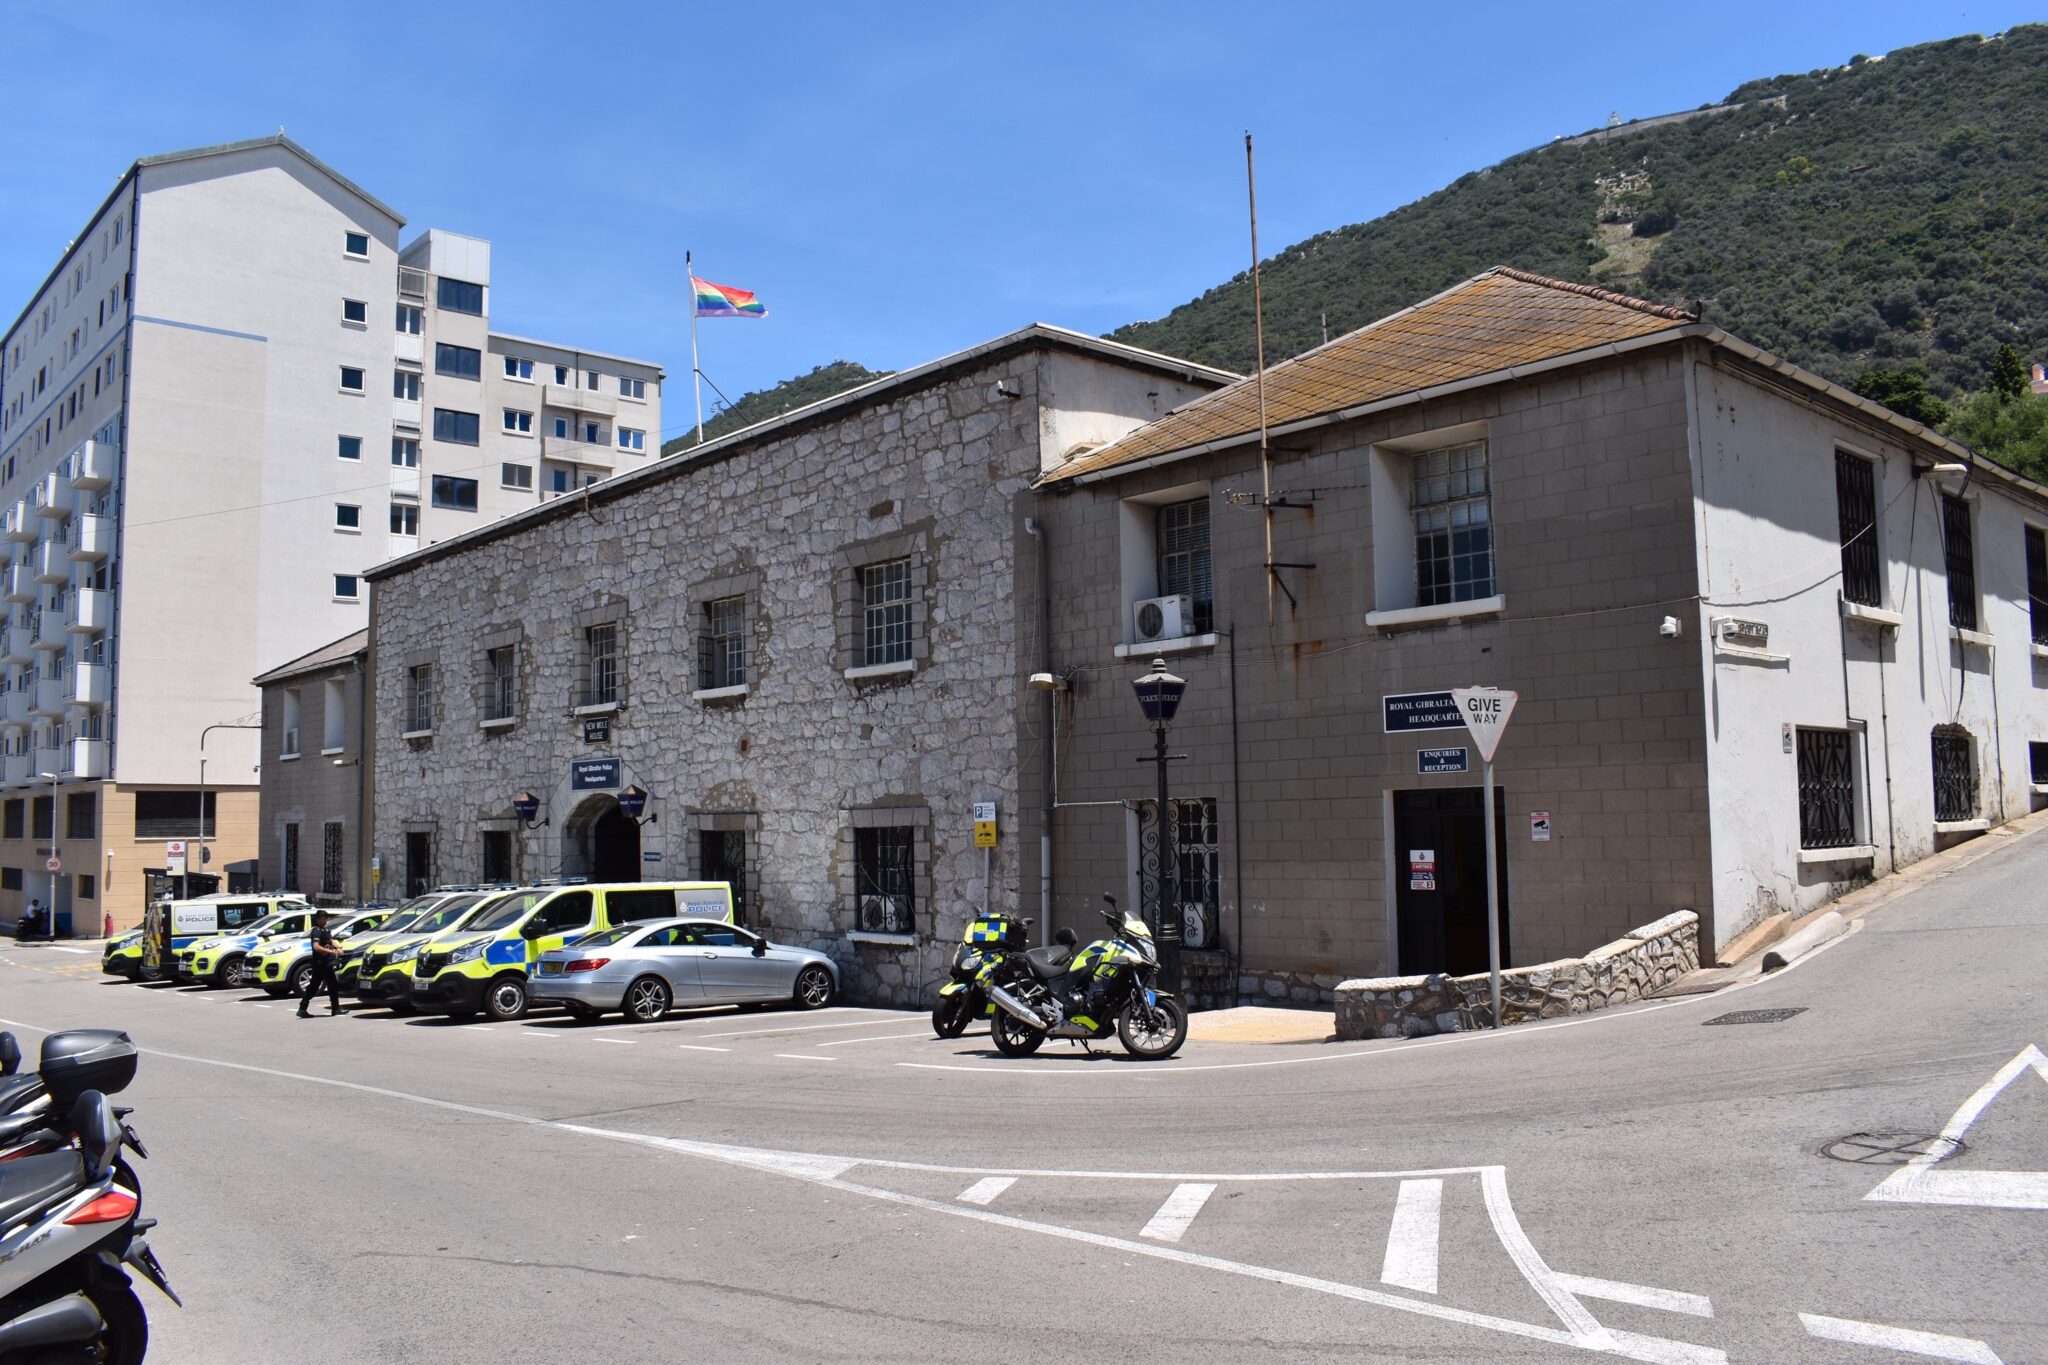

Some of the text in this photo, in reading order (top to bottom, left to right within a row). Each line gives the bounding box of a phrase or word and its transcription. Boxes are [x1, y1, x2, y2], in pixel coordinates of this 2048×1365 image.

[1390, 699, 1456, 711] ROYAL GIBRALTA
[1468, 698, 1501, 712] GIVE
[1409, 712, 1463, 723] HEADQUARTE
[1473, 713, 1498, 724] WAY
[589, 731, 604, 740] HOUSE
[1424, 750, 1460, 758] ENQUIRIES
[1424, 764, 1461, 772] RECEPTION
